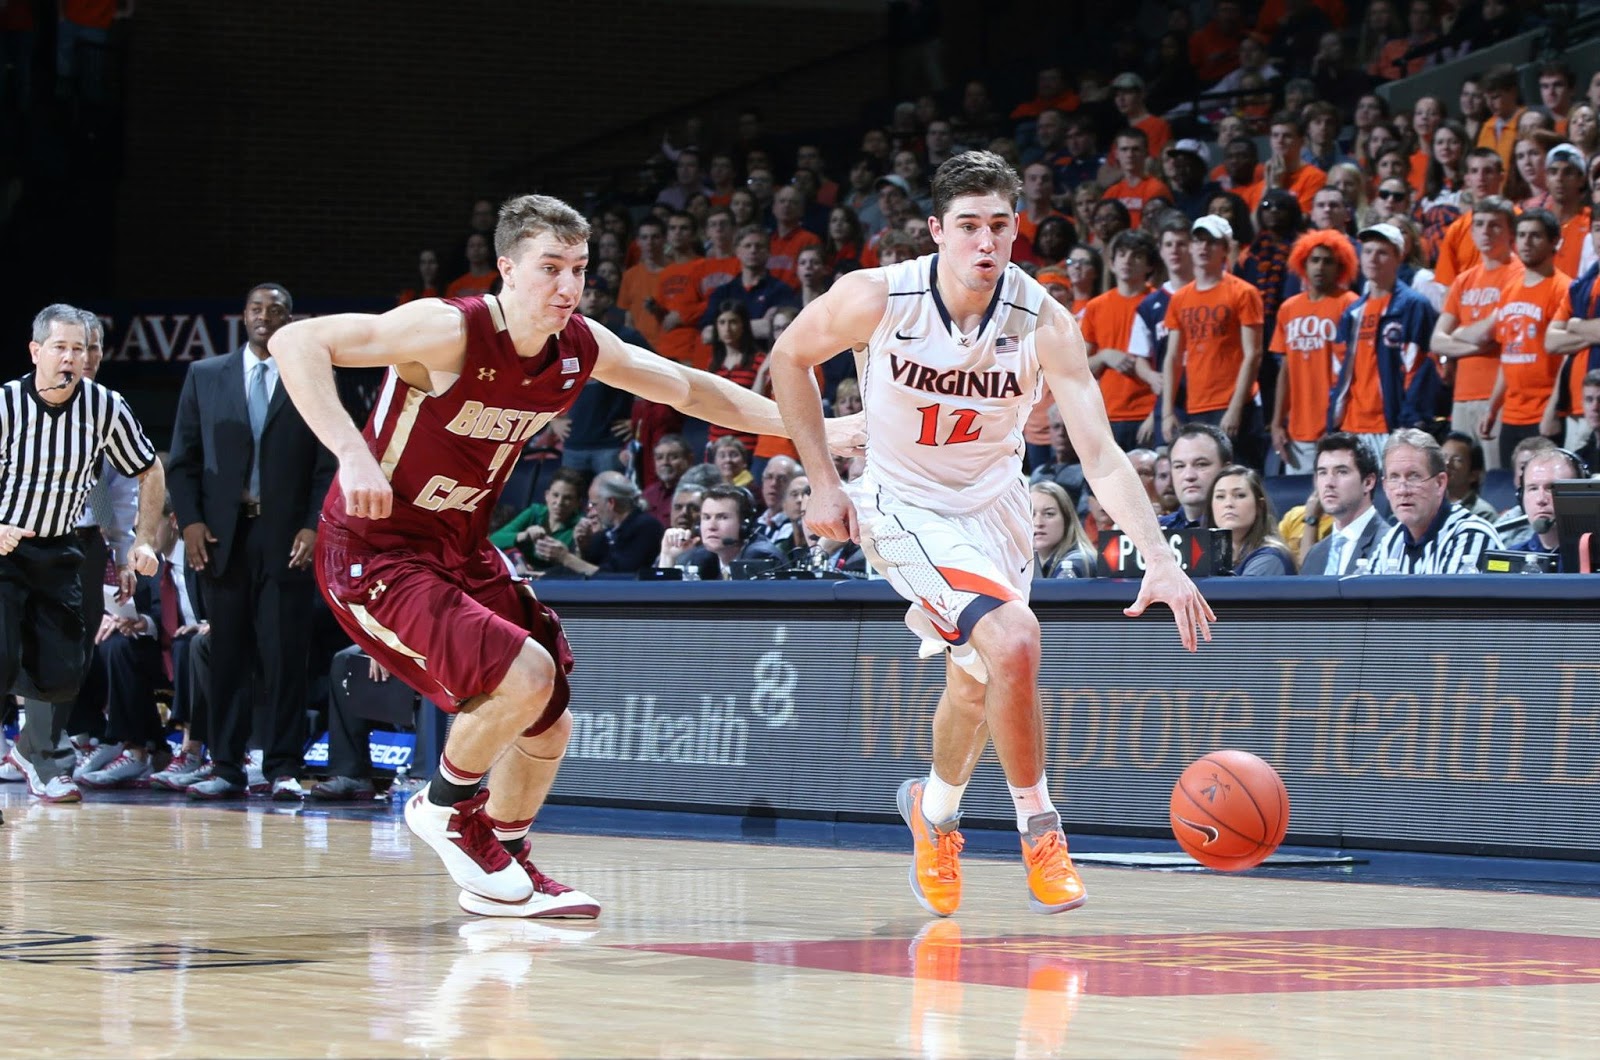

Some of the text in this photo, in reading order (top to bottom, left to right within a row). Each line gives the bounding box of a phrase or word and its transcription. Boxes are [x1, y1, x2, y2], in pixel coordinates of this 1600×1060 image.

[1181, 304, 1232, 323] HOO
[1286, 315, 1337, 341] HOO
[889, 352, 1024, 399] VIRGINIA
[445, 400, 565, 442] BOSTO
[915, 402, 983, 447] 12
[1268, 653, 1528, 783] Health
